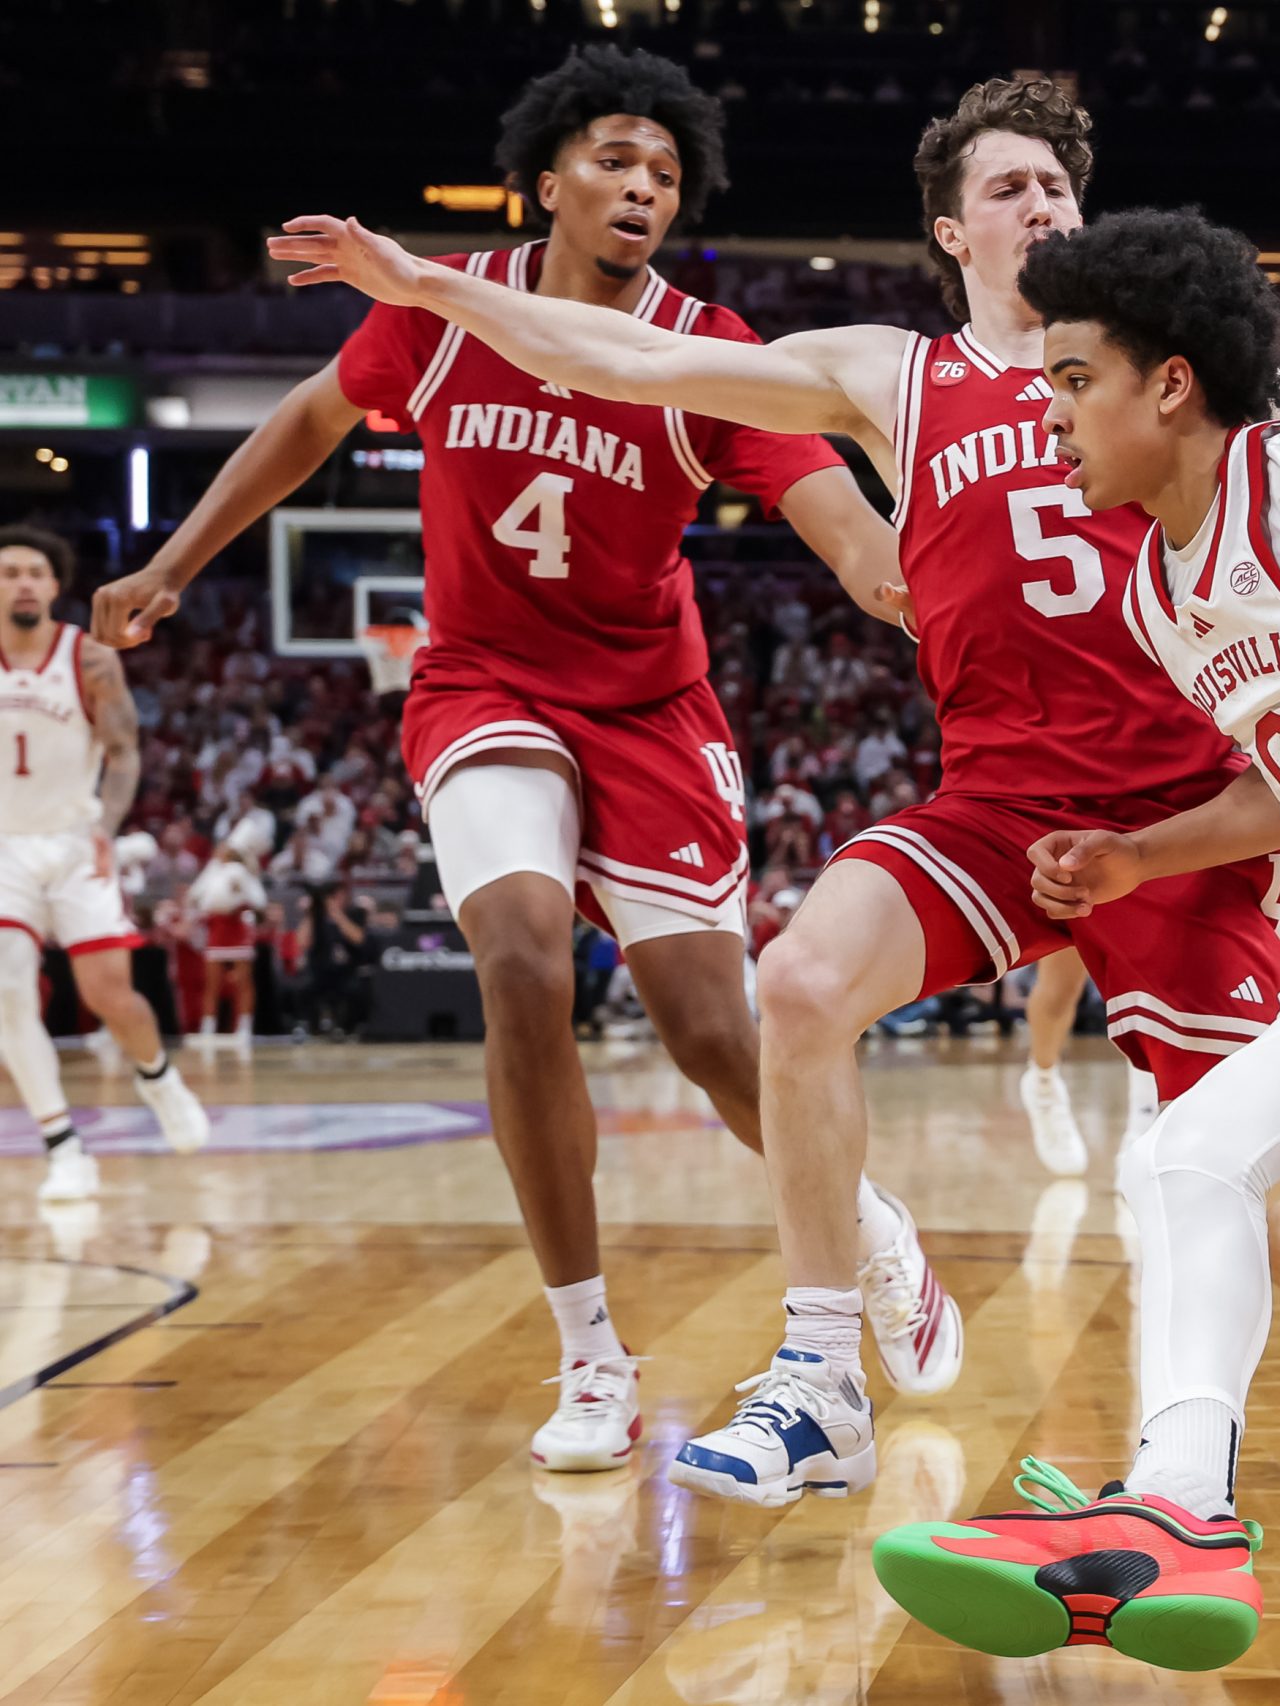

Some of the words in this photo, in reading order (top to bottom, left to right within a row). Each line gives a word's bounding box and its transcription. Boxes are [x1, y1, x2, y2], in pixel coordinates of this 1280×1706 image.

[445, 403, 645, 492] INDIANA
[492, 471, 574, 578] 4
[1007, 484, 1106, 618] 5
[15, 732, 31, 777] 1
